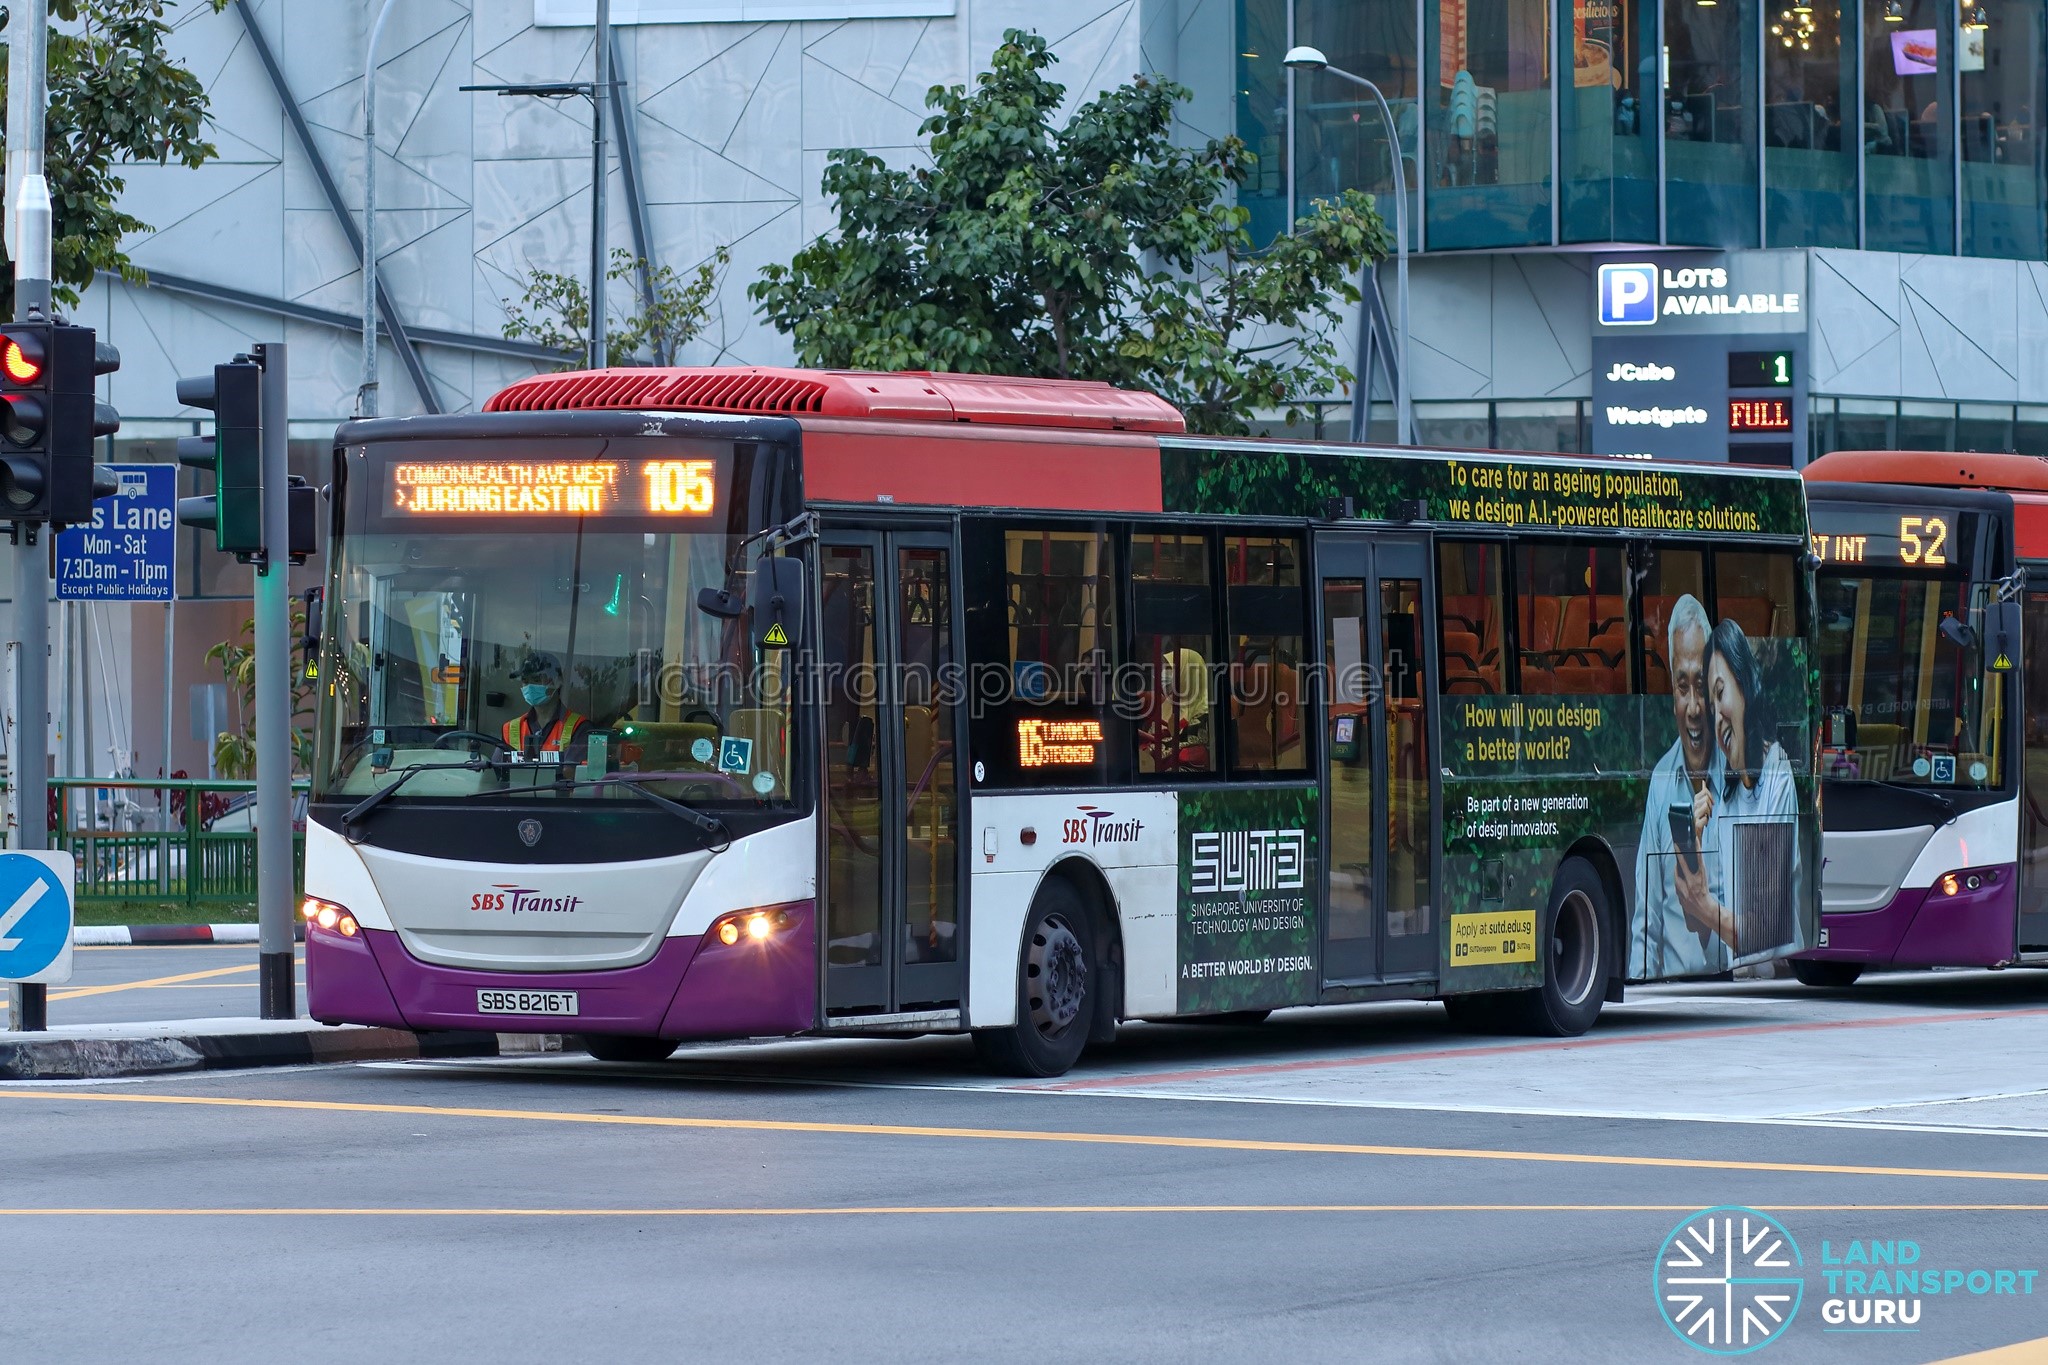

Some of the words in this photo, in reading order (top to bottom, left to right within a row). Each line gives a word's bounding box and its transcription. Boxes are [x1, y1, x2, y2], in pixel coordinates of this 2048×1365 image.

[1663, 268, 1728, 289] LOTS
[1611, 270, 1649, 318] P
[1663, 293, 1800, 316] AVAILABLE
[1606, 363, 1676, 381] JCube
[1774, 355, 1790, 383] 1
[1606, 406, 1708, 428] Westgate
[1731, 402, 1789, 427] FULL
[396, 465, 533, 485] COMMONWEALTH
[535, 465, 569, 485] AVE
[572, 465, 617, 485] WEST
[644, 461, 714, 512] 105
[1448, 460, 1467, 487] To
[1471, 467, 1503, 489] care
[1507, 464, 1528, 491] for
[1532, 471, 1550, 491] an
[1553, 468, 1601, 498] ageing
[1605, 471, 1683, 501] population,
[408, 485, 502, 512] JURONG
[503, 485, 564, 512] EAST
[566, 485, 603, 512] INT
[113, 499, 172, 530] Lane
[1449, 499, 1470, 520] we
[1475, 495, 1523, 527] design
[1528, 499, 1619, 530] A.I.-powered
[1623, 502, 1694, 529] healthcare
[1698, 505, 1761, 531] solutions.
[84, 534, 111, 555] Mon
[124, 534, 147, 555] Sat
[1835, 536, 1867, 562] INT
[1900, 517, 1947, 564] 52
[63, 558, 117, 579] 7.30am
[133, 559, 168, 584] 11pm
[62, 583, 93, 597] Except
[96, 583, 125, 595] Public
[128, 583, 168, 598] Holidays
[1465, 703, 1496, 727] How
[1500, 703, 1524, 727] will
[1528, 708, 1553, 731] you
[1557, 703, 1601, 731] design
[1466, 742, 1475, 761] a
[1478, 736, 1521, 761] better
[1525, 736, 1571, 760] world?
[1467, 796, 1479, 813] Be
[1481, 796, 1500, 815] part
[1502, 795, 1512, 812] of
[1513, 799, 1519, 811] a
[1521, 797, 1539, 811] new
[1542, 793, 1589, 813] generation
[1062, 818, 1088, 844] SBS
[1085, 811, 1145, 848] Transit
[1466, 822, 1477, 838] of
[1478, 819, 1508, 840] design
[1510, 820, 1559, 837] innovators.
[471, 893, 505, 911] SBS
[503, 889, 585, 915] Transit
[1191, 901, 1240, 917] SINGAPORE
[1242, 899, 1290, 915] UNIVERSITY
[1292, 898, 1304, 912] OF
[1191, 919, 1249, 935] TECHNOLOGY
[1251, 917, 1270, 932] AND
[1273, 915, 1304, 930] DESIGN
[1455, 923, 1478, 938] Apply
[1480, 922, 1488, 935] at
[1489, 919, 1532, 935] sutd.edu.sg
[1182, 963, 1189, 979] A
[1191, 960, 1226, 978] BETTER
[1227, 958, 1261, 976] WORLD
[1263, 957, 1276, 973] BY
[1277, 956, 1313, 972] DESIGN.
